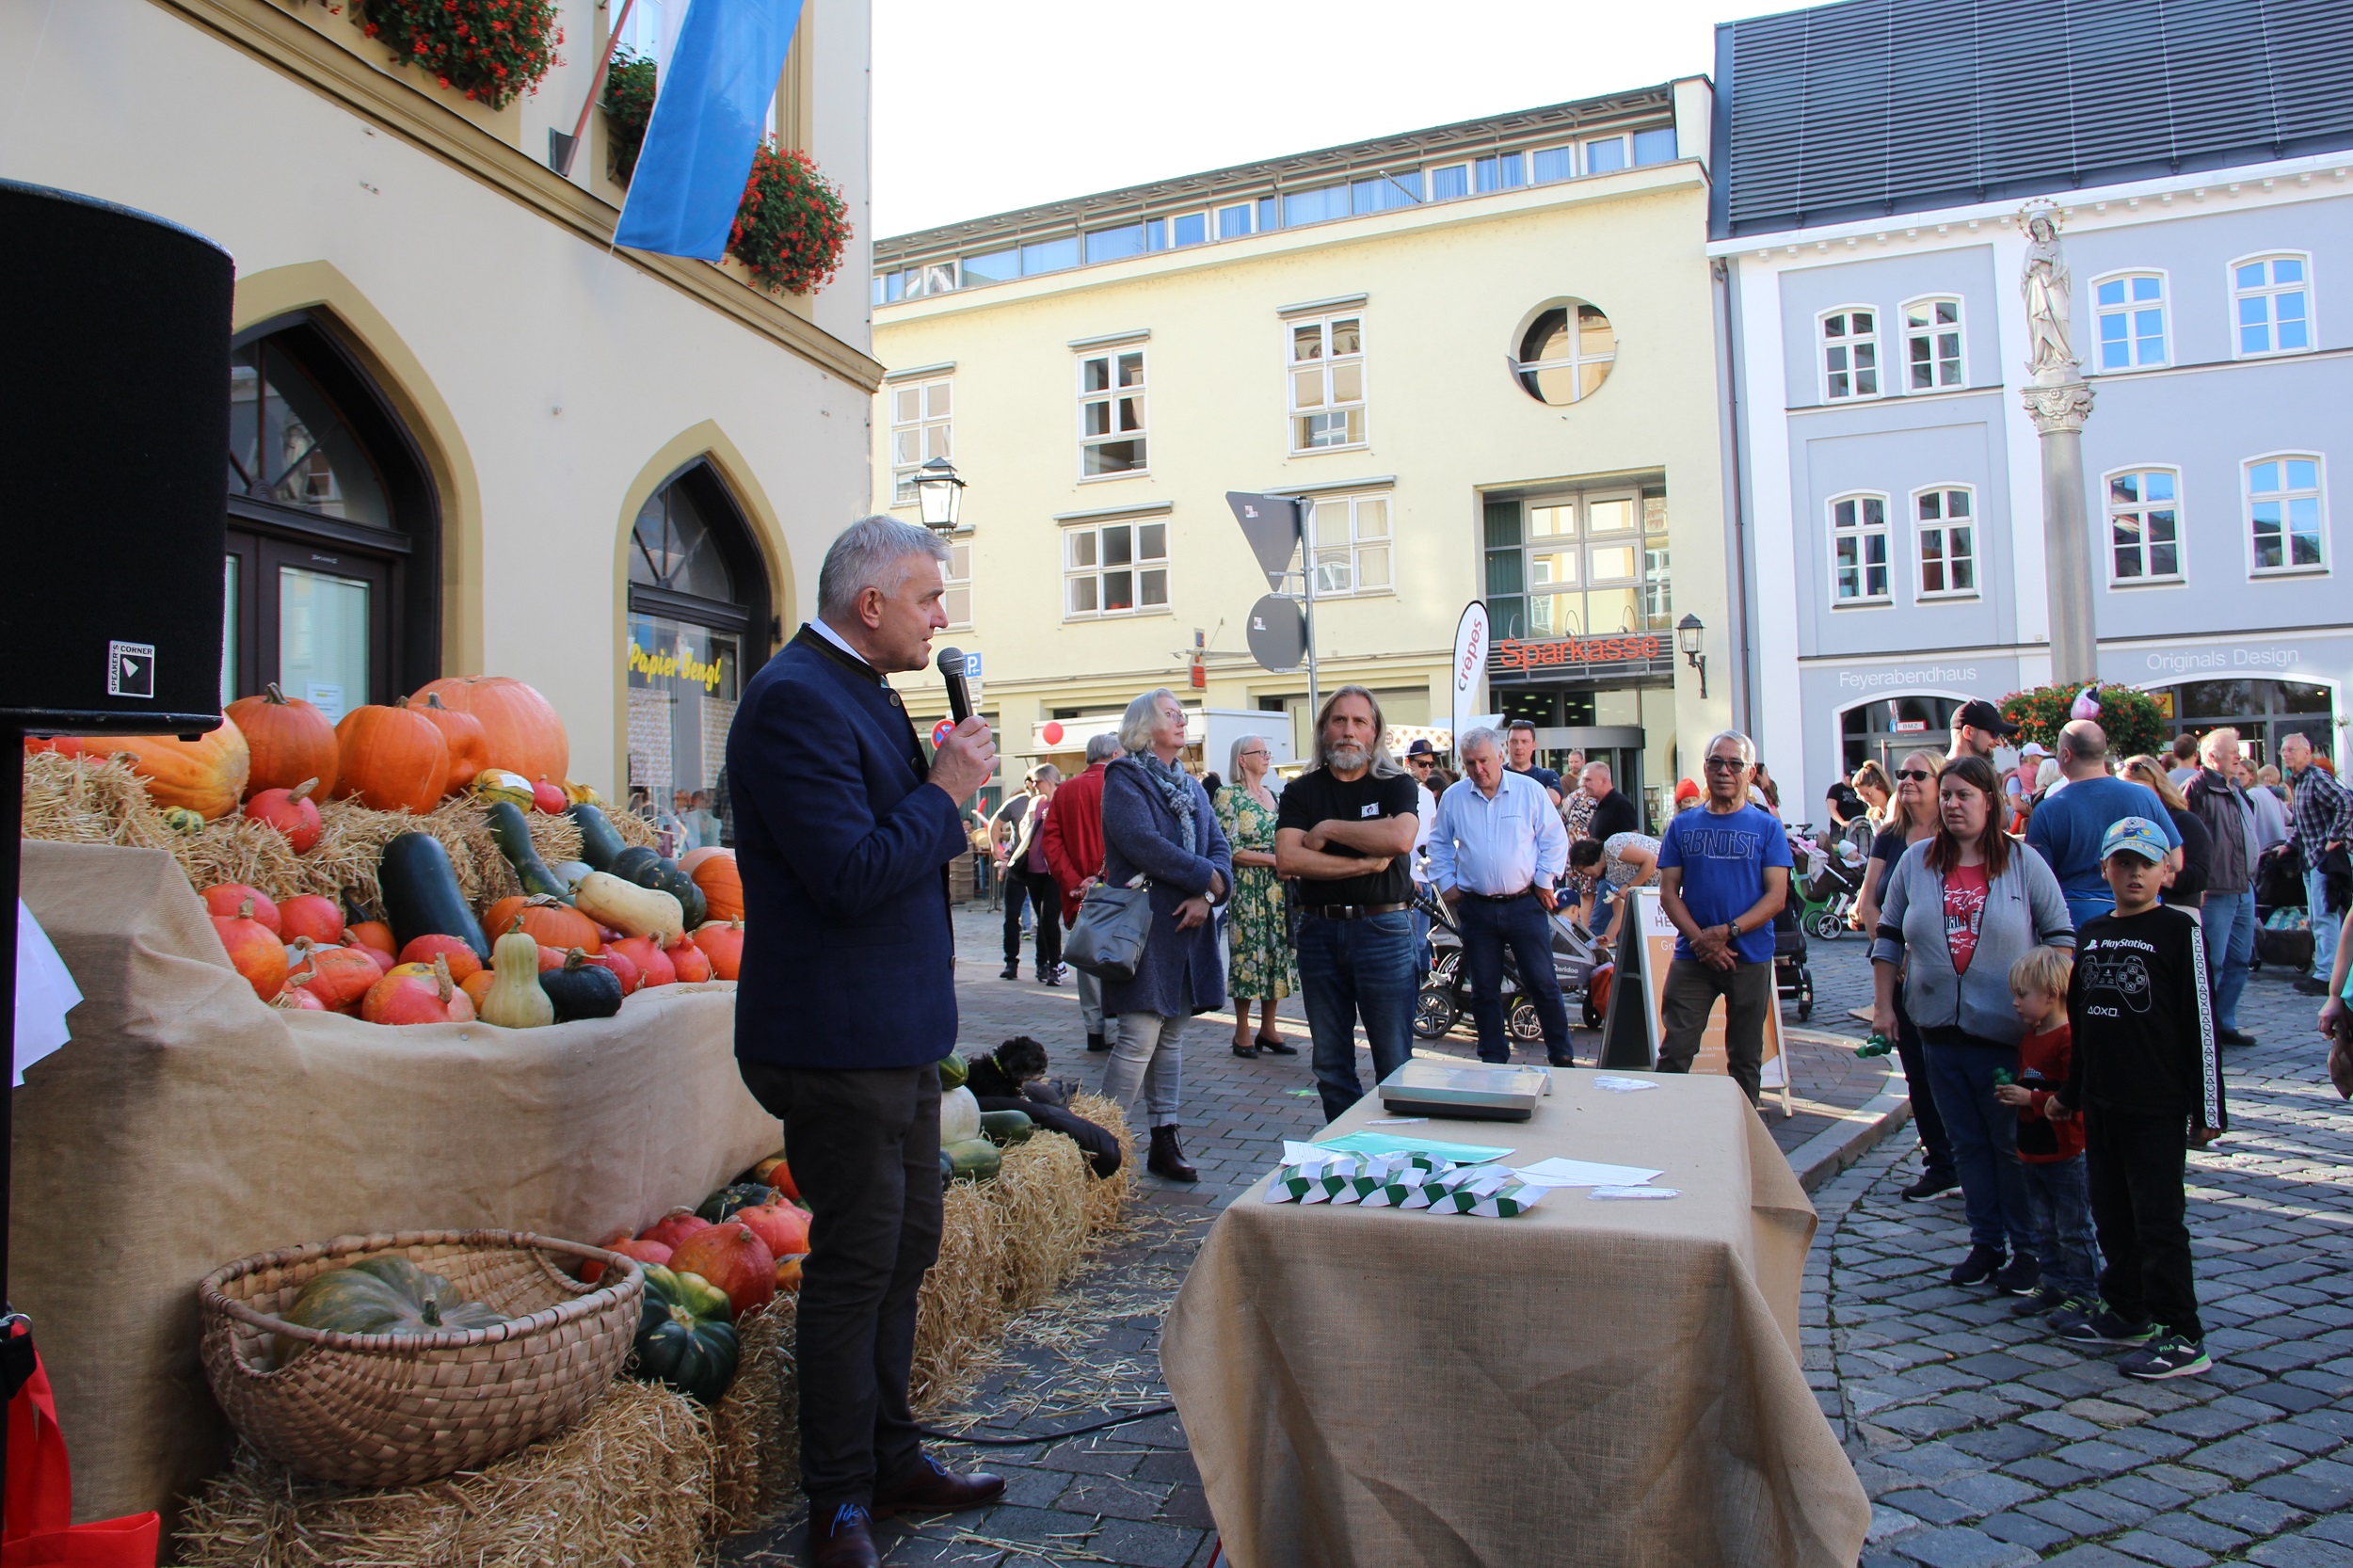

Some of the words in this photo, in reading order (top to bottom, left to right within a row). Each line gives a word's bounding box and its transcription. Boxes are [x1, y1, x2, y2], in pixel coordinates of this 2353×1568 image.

[120, 645, 152, 655] CORNER
[1499, 635, 1660, 672] Sparkasse
[628, 643, 680, 683] Papier
[680, 652, 722, 692] Bengl
[968, 656, 978, 675] P
[2146, 650, 2226, 673] Originals
[2233, 648, 2298, 667] Design
[1839, 666, 1977, 690] Feyerabendhaus
[1655, 916, 1675, 927] HE
[2101, 938, 2153, 952] PlayStation
[2158, 1343, 2174, 1352] FILA
